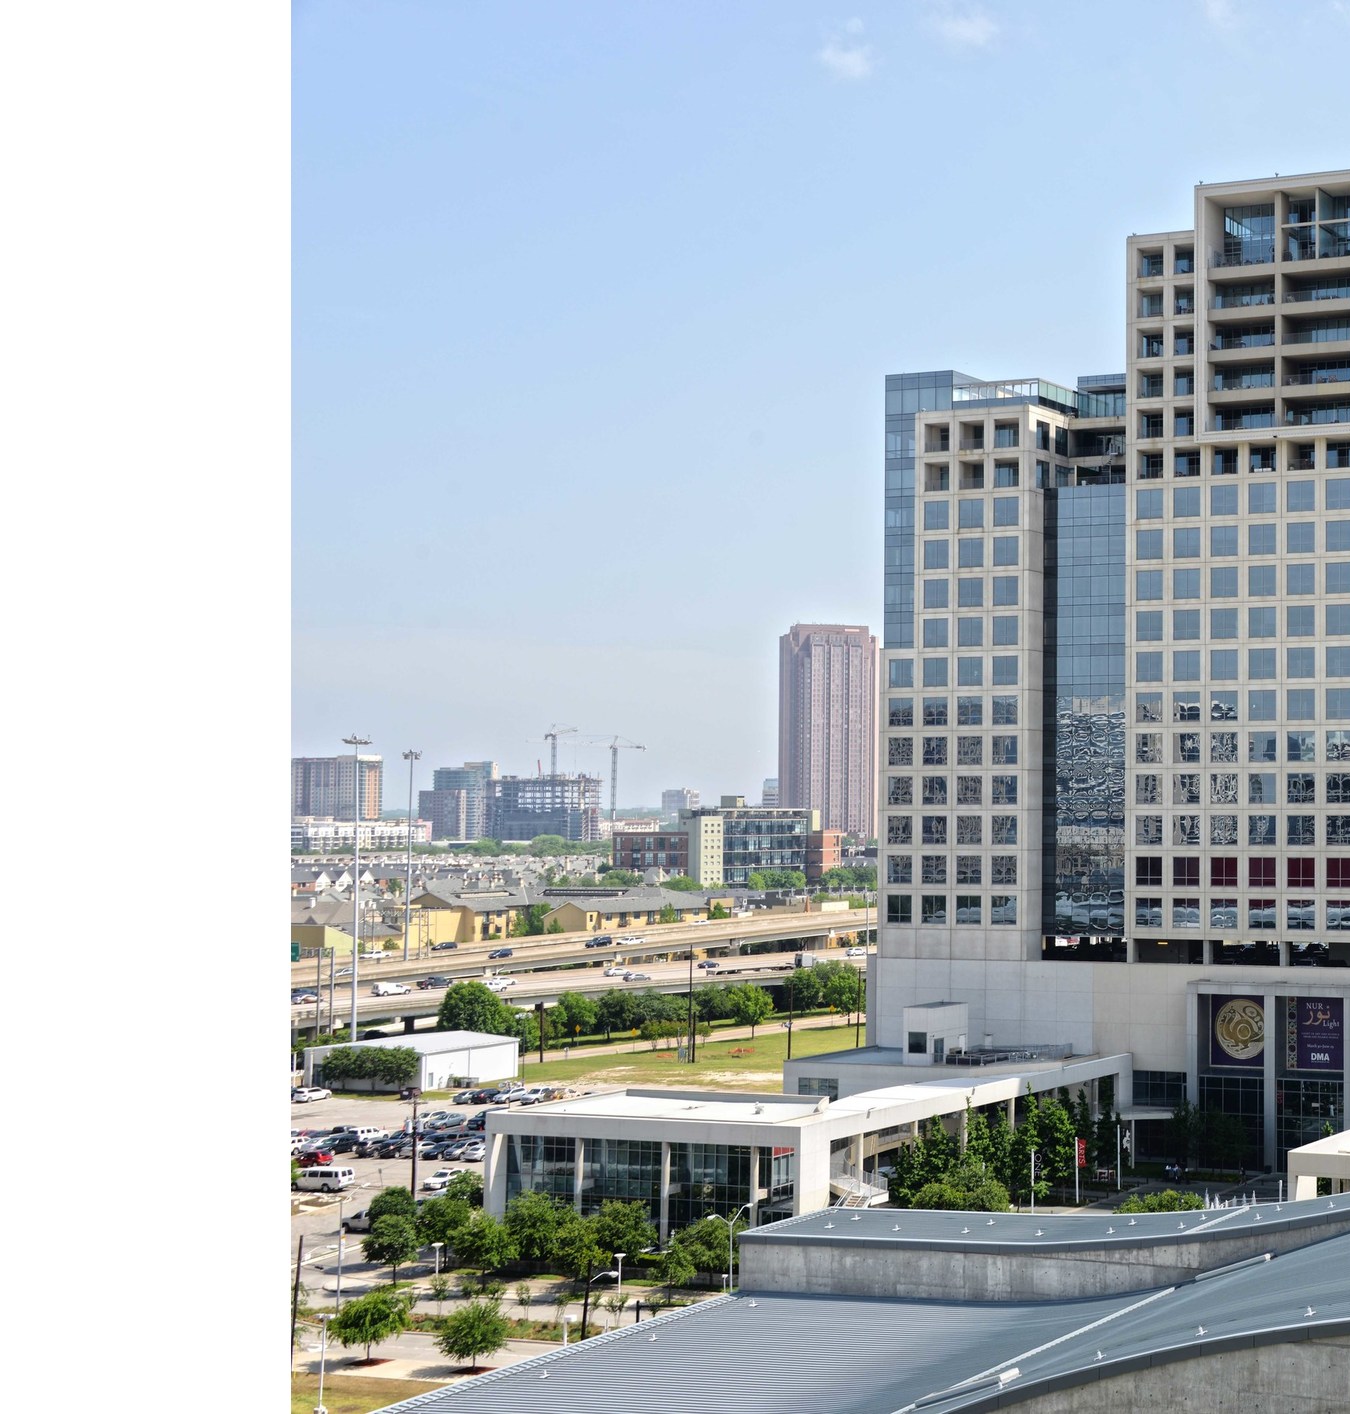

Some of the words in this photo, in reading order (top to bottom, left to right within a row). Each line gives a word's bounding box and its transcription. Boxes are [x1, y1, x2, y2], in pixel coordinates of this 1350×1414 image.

[1306, 1002, 1324, 1010] NUR
[1302, 1005, 1330, 1025] نور
[1323, 1019, 1340, 1030] Light
[1311, 1052, 1330, 1061] DMA
[1078, 1143, 1086, 1164] ARTS
[1034, 1154, 1042, 1177] ONE
